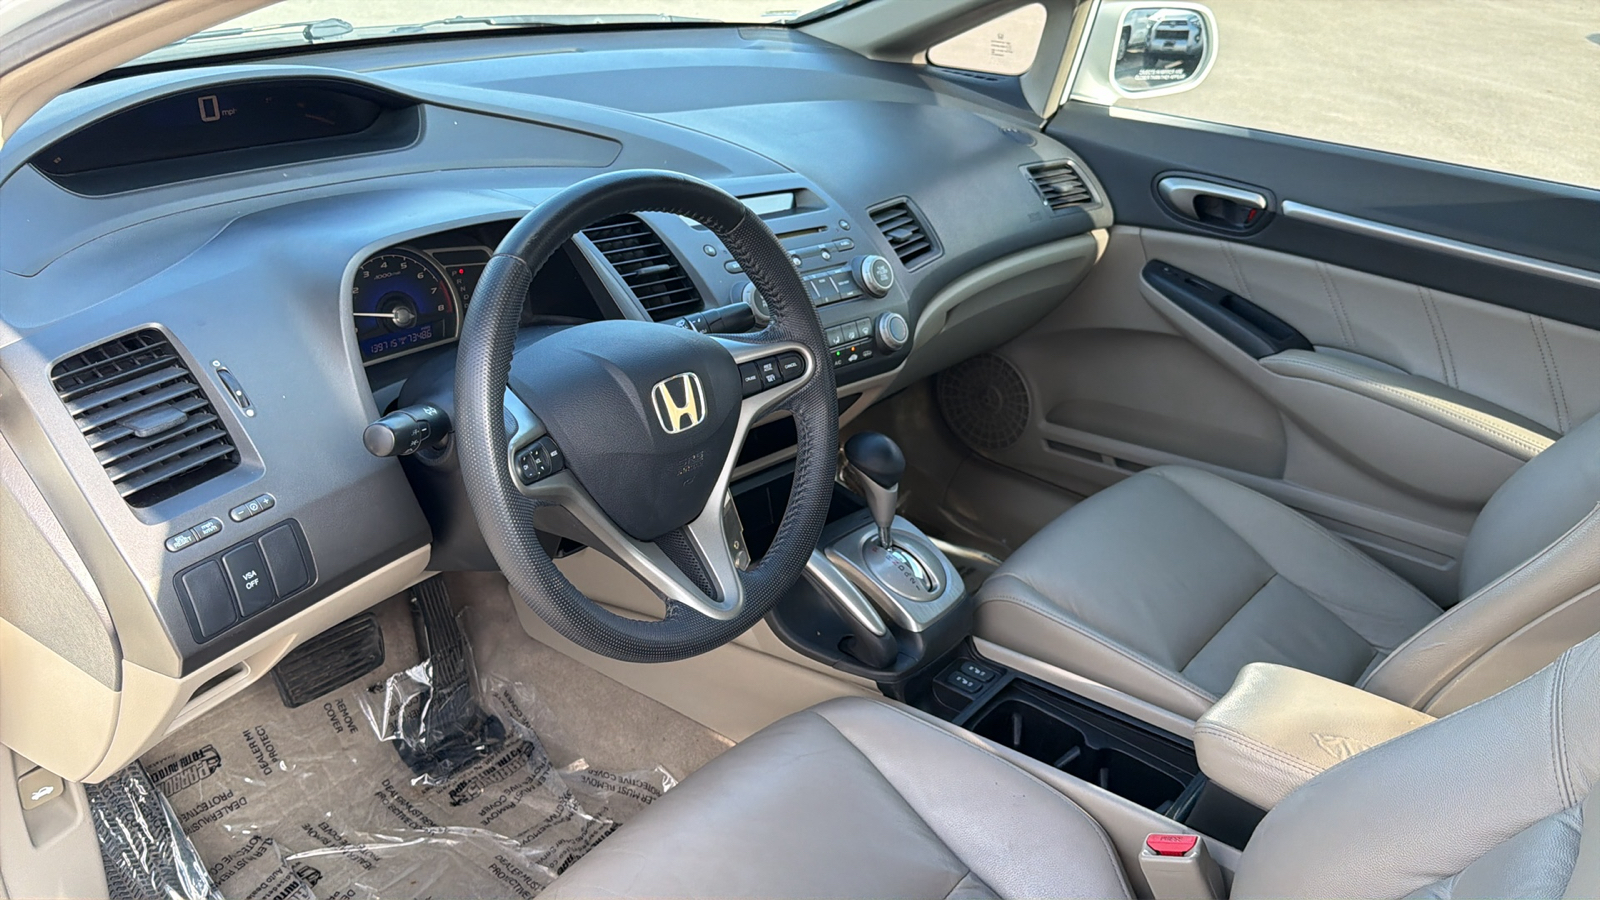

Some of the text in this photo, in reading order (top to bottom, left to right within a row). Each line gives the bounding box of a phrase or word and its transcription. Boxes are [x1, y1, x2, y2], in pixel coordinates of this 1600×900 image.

[198, 95, 220, 122] 0
[431, 287, 438, 295] 7
[438, 304, 445, 312] 8
[242, 570, 258, 582] VSA
[245, 578, 260, 590] OFF
[323, 702, 344, 733] COVER
[335, 698, 359, 734] REMOVE
[248, 741, 273, 776] DEALER
[181, 789, 234, 822] PROTECTIVE
[209, 796, 248, 822] DEALER
[266, 867, 284, 884] Auto
